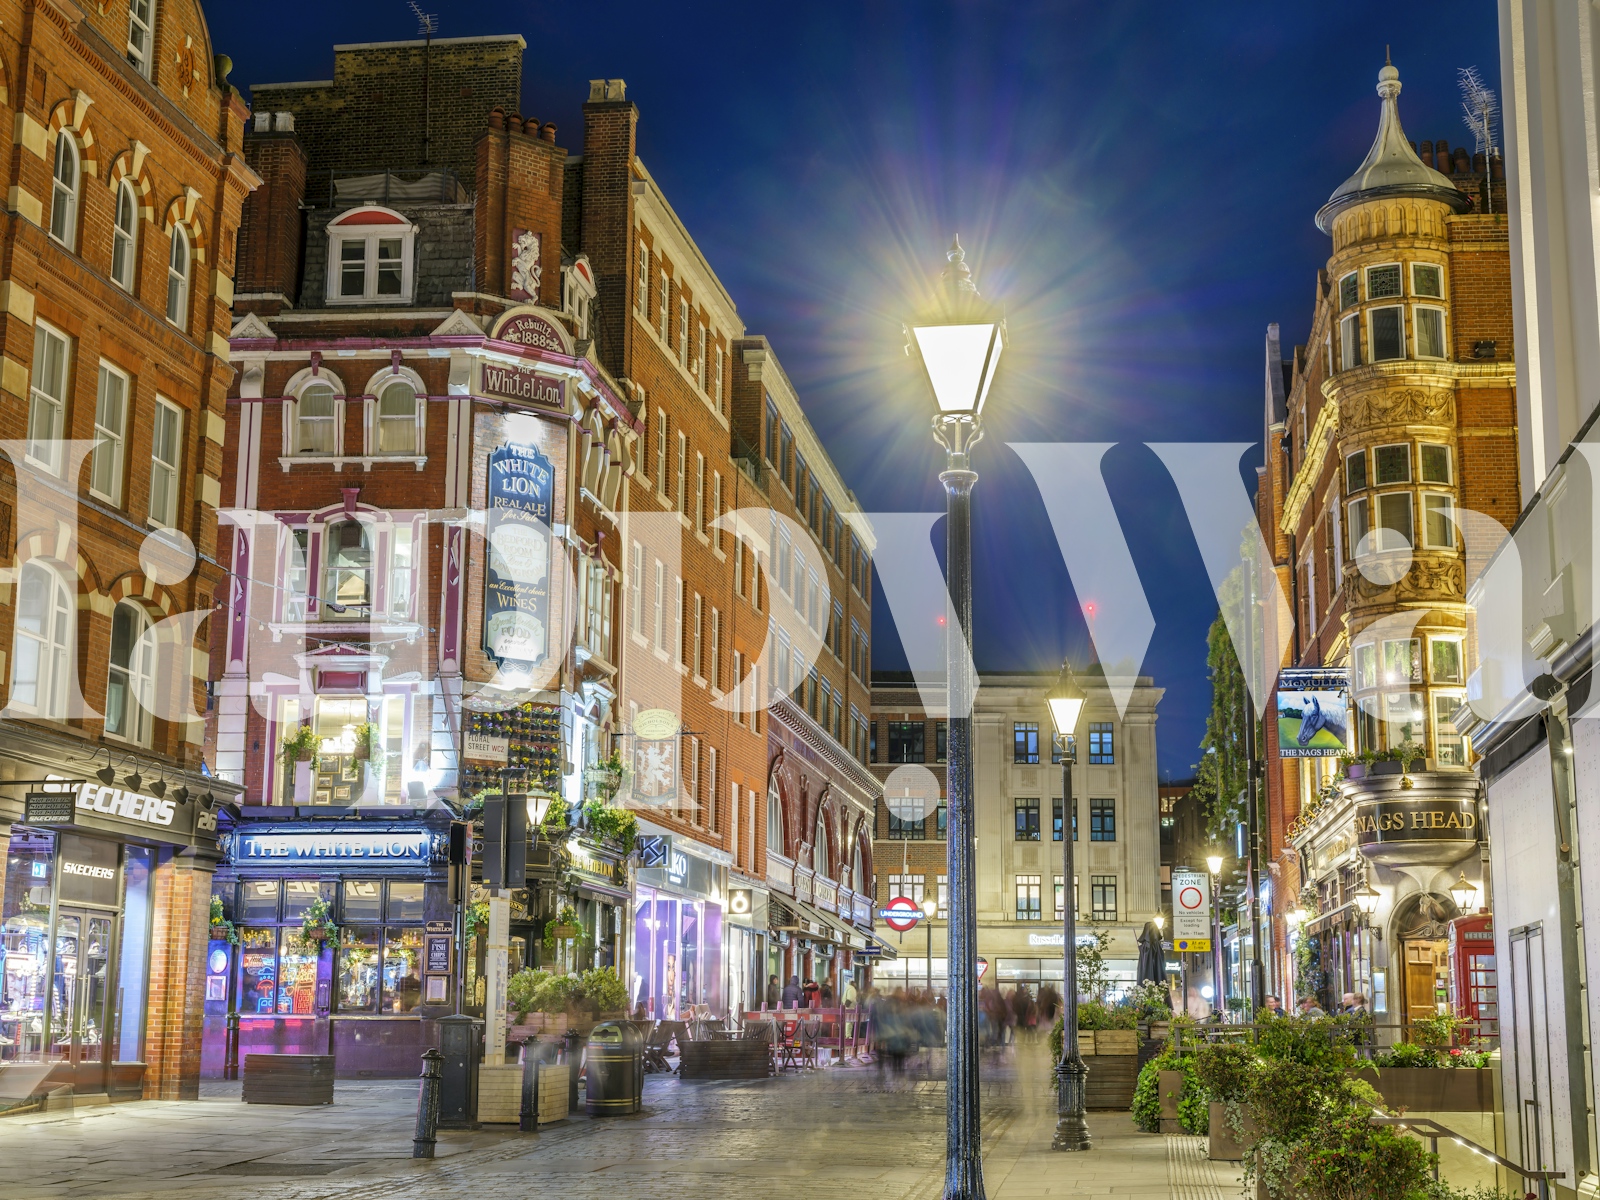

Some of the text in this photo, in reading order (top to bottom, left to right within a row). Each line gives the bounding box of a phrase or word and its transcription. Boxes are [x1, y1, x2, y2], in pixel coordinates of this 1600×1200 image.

[515, 319, 552, 338] Rebuilt
[522, 332, 546, 347] 1888
[517, 366, 531, 374] THE
[510, 444, 536, 460] THE
[493, 459, 549, 486] WHITE
[502, 478, 541, 498] LION
[494, 496, 546, 518] REAL ALE
[501, 510, 538, 523] for Sale
[512, 527, 528, 536] THE
[496, 532, 542, 551] BEDFORD
[504, 545, 532, 558] ROOM
[499, 581, 528, 594] Excellent
[528, 588, 546, 596] choice
[497, 593, 537, 612] WINES
[501, 626, 531, 639] FOOD
[468, 735, 490, 743] FLORAL
[468, 743, 505, 753] STREET WC2
[43, 774, 176, 826] SKECHERS
[198, 812, 216, 831] 26
[1357, 812, 1405, 834] NAGS
[1410, 811, 1475, 830] HEAD
[245, 839, 422, 857] THE WHITE LION
[63, 863, 115, 880] SKECHERS
[1030, 934, 1060, 945] Russell
